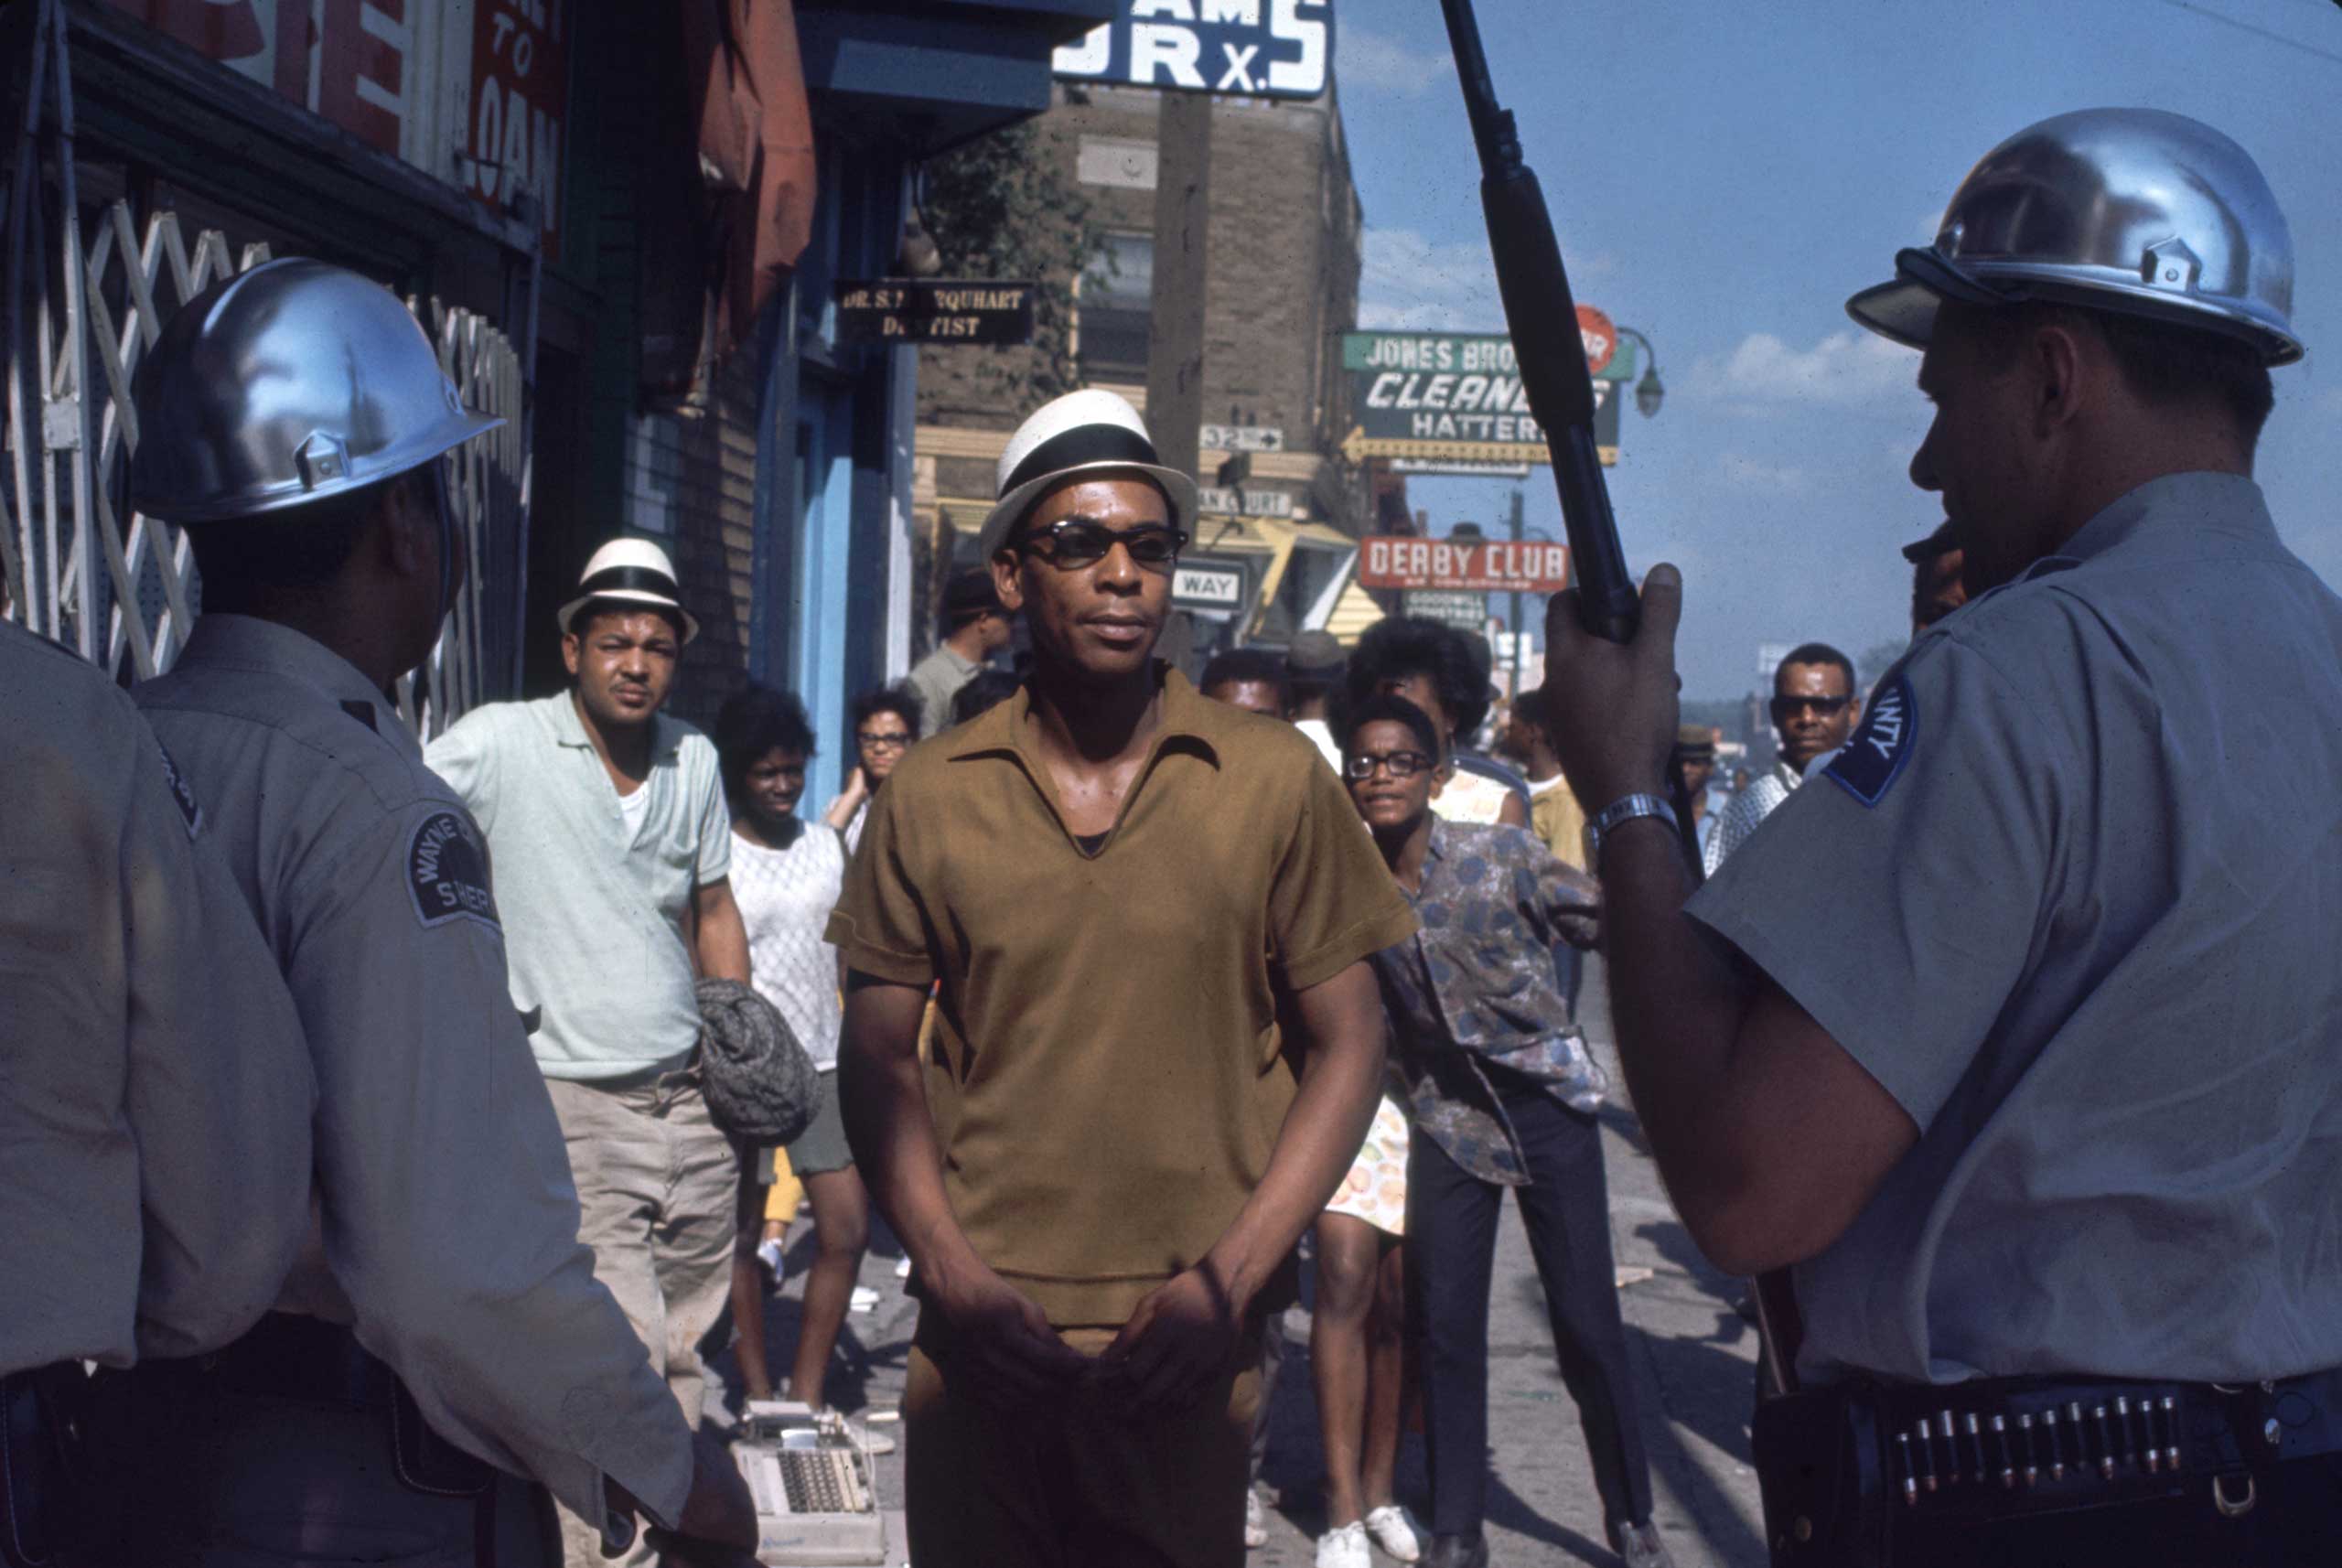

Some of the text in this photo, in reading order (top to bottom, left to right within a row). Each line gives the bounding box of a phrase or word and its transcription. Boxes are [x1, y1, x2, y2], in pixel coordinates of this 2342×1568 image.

[493, 12, 533, 77] TO
[1366, 338, 1520, 372] JONES BRO
[1412, 413, 1546, 441] HATTER
[1370, 541, 1564, 581] DERBY CLUB
[1182, 575, 1232, 596] WAY
[417, 817, 457, 884] WAYNE
